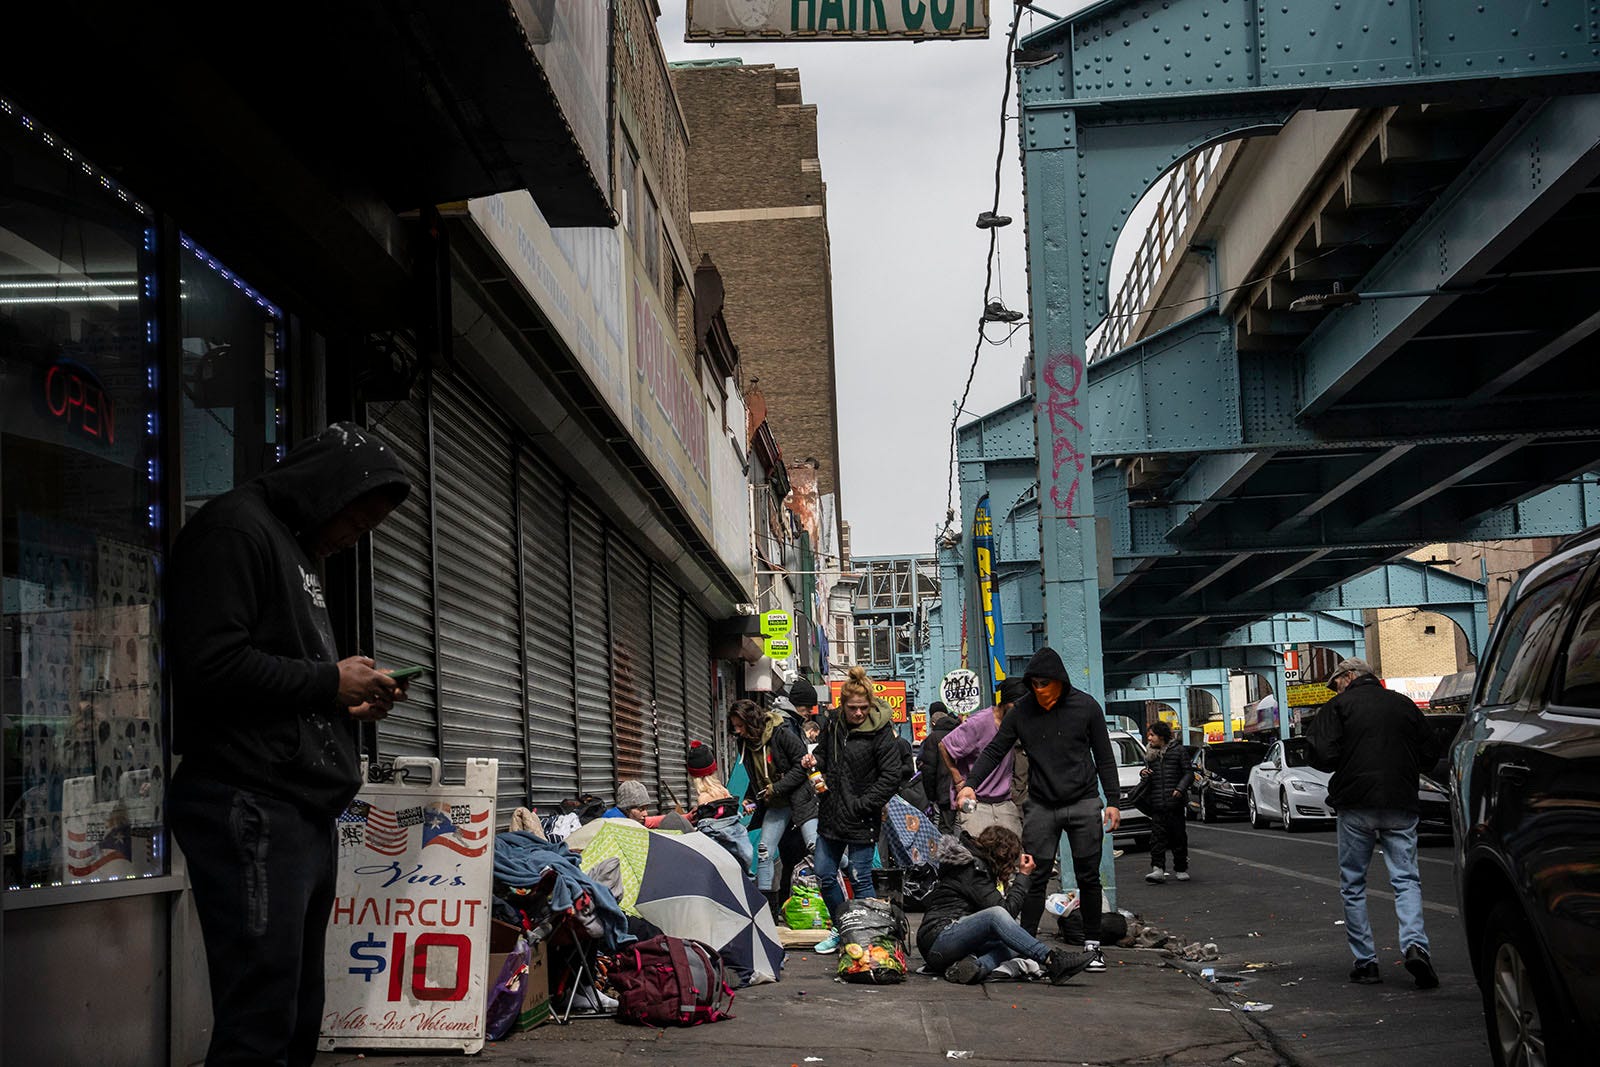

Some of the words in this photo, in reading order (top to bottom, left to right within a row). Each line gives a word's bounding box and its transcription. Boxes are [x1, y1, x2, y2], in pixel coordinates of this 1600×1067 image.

[791, 0, 887, 31] HAIR
[901, 0, 974, 31] CUT
[634, 272, 680, 446] DOLLAR
[46, 366, 115, 445] OPEN
[1285, 671, 1297, 679] OP
[333, 897, 482, 927] HAIRCUT
[348, 932, 472, 1002] $10
[410, 1008, 479, 1031] Welcome!
